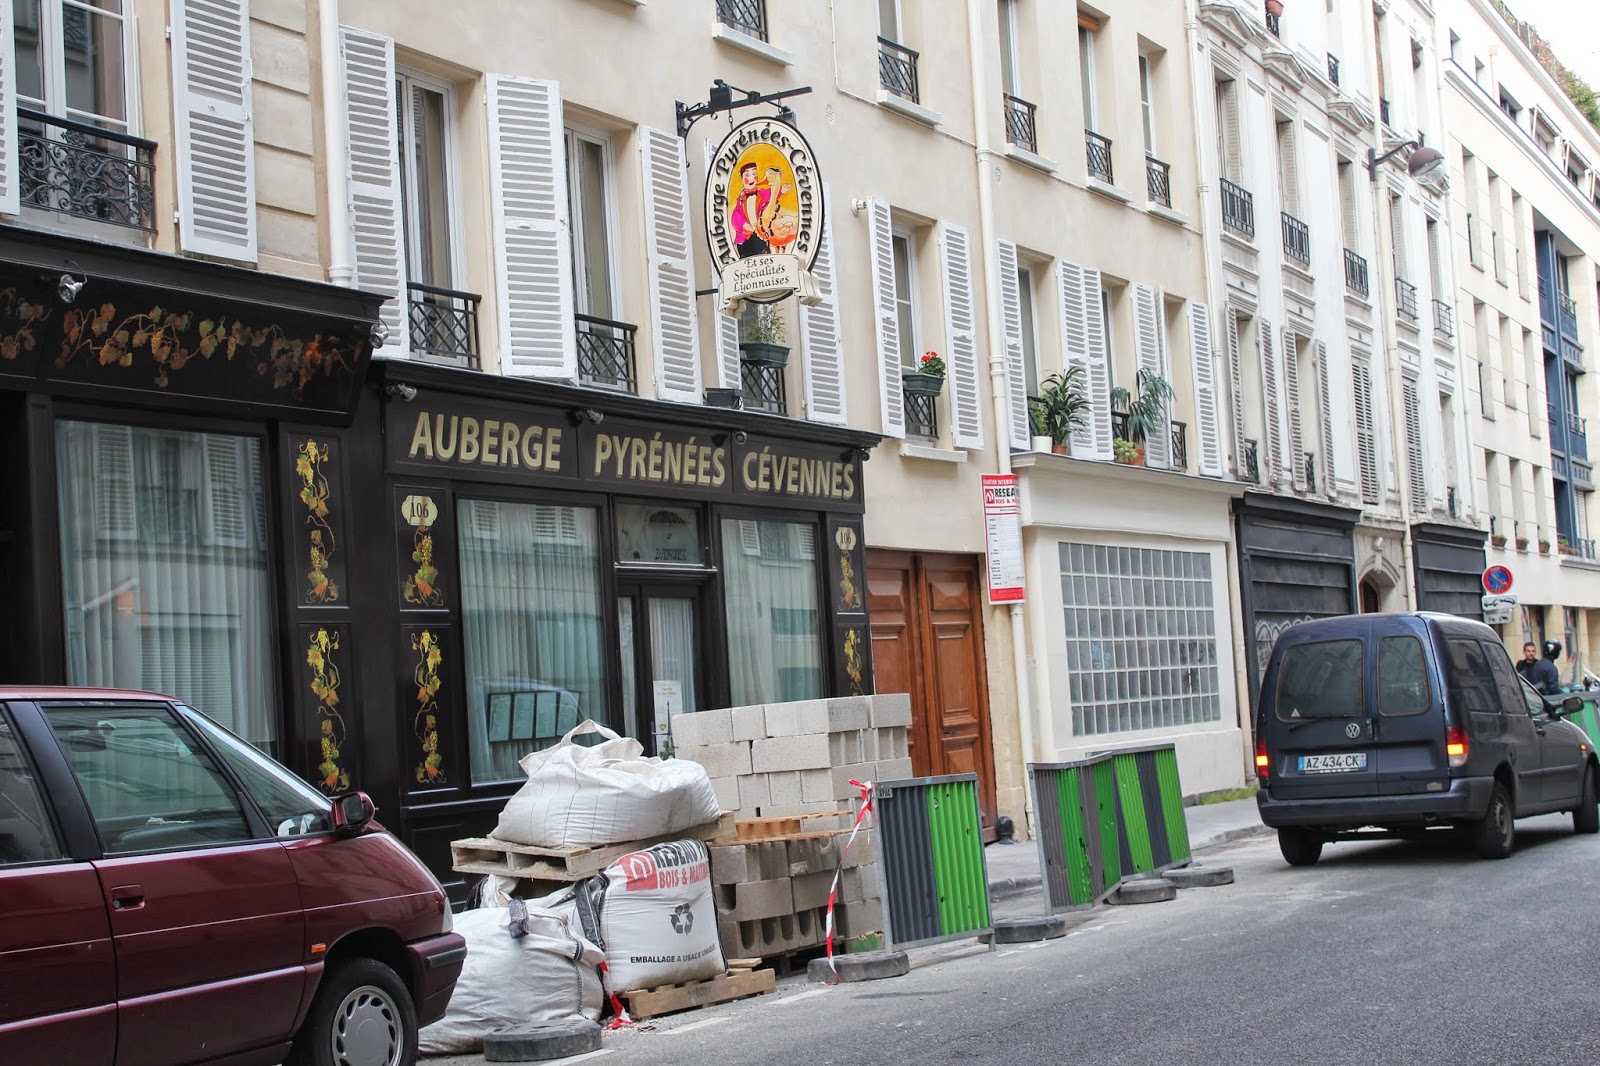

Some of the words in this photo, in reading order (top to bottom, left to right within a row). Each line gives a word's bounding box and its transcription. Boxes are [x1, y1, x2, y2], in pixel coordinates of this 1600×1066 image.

[709, 183, 736, 264] Auberge
[744, 258, 756, 268] Et
[759, 257, 774, 265] ses
[734, 264, 785, 284] Spécialités
[734, 276, 789, 294] Lyonnaises
[408, 411, 562, 472] AUBERGE
[594, 432, 726, 487] PYRÉNÉES
[741, 446, 855, 500] CÉVENNES
[410, 503, 429, 518] 106
[840, 532, 852, 544] 106
[659, 869, 679, 889] BOIS
[681, 867, 688, 886] &
[630, 955, 675, 964] EMBALLAGE
[682, 951, 701, 962] USAGE
